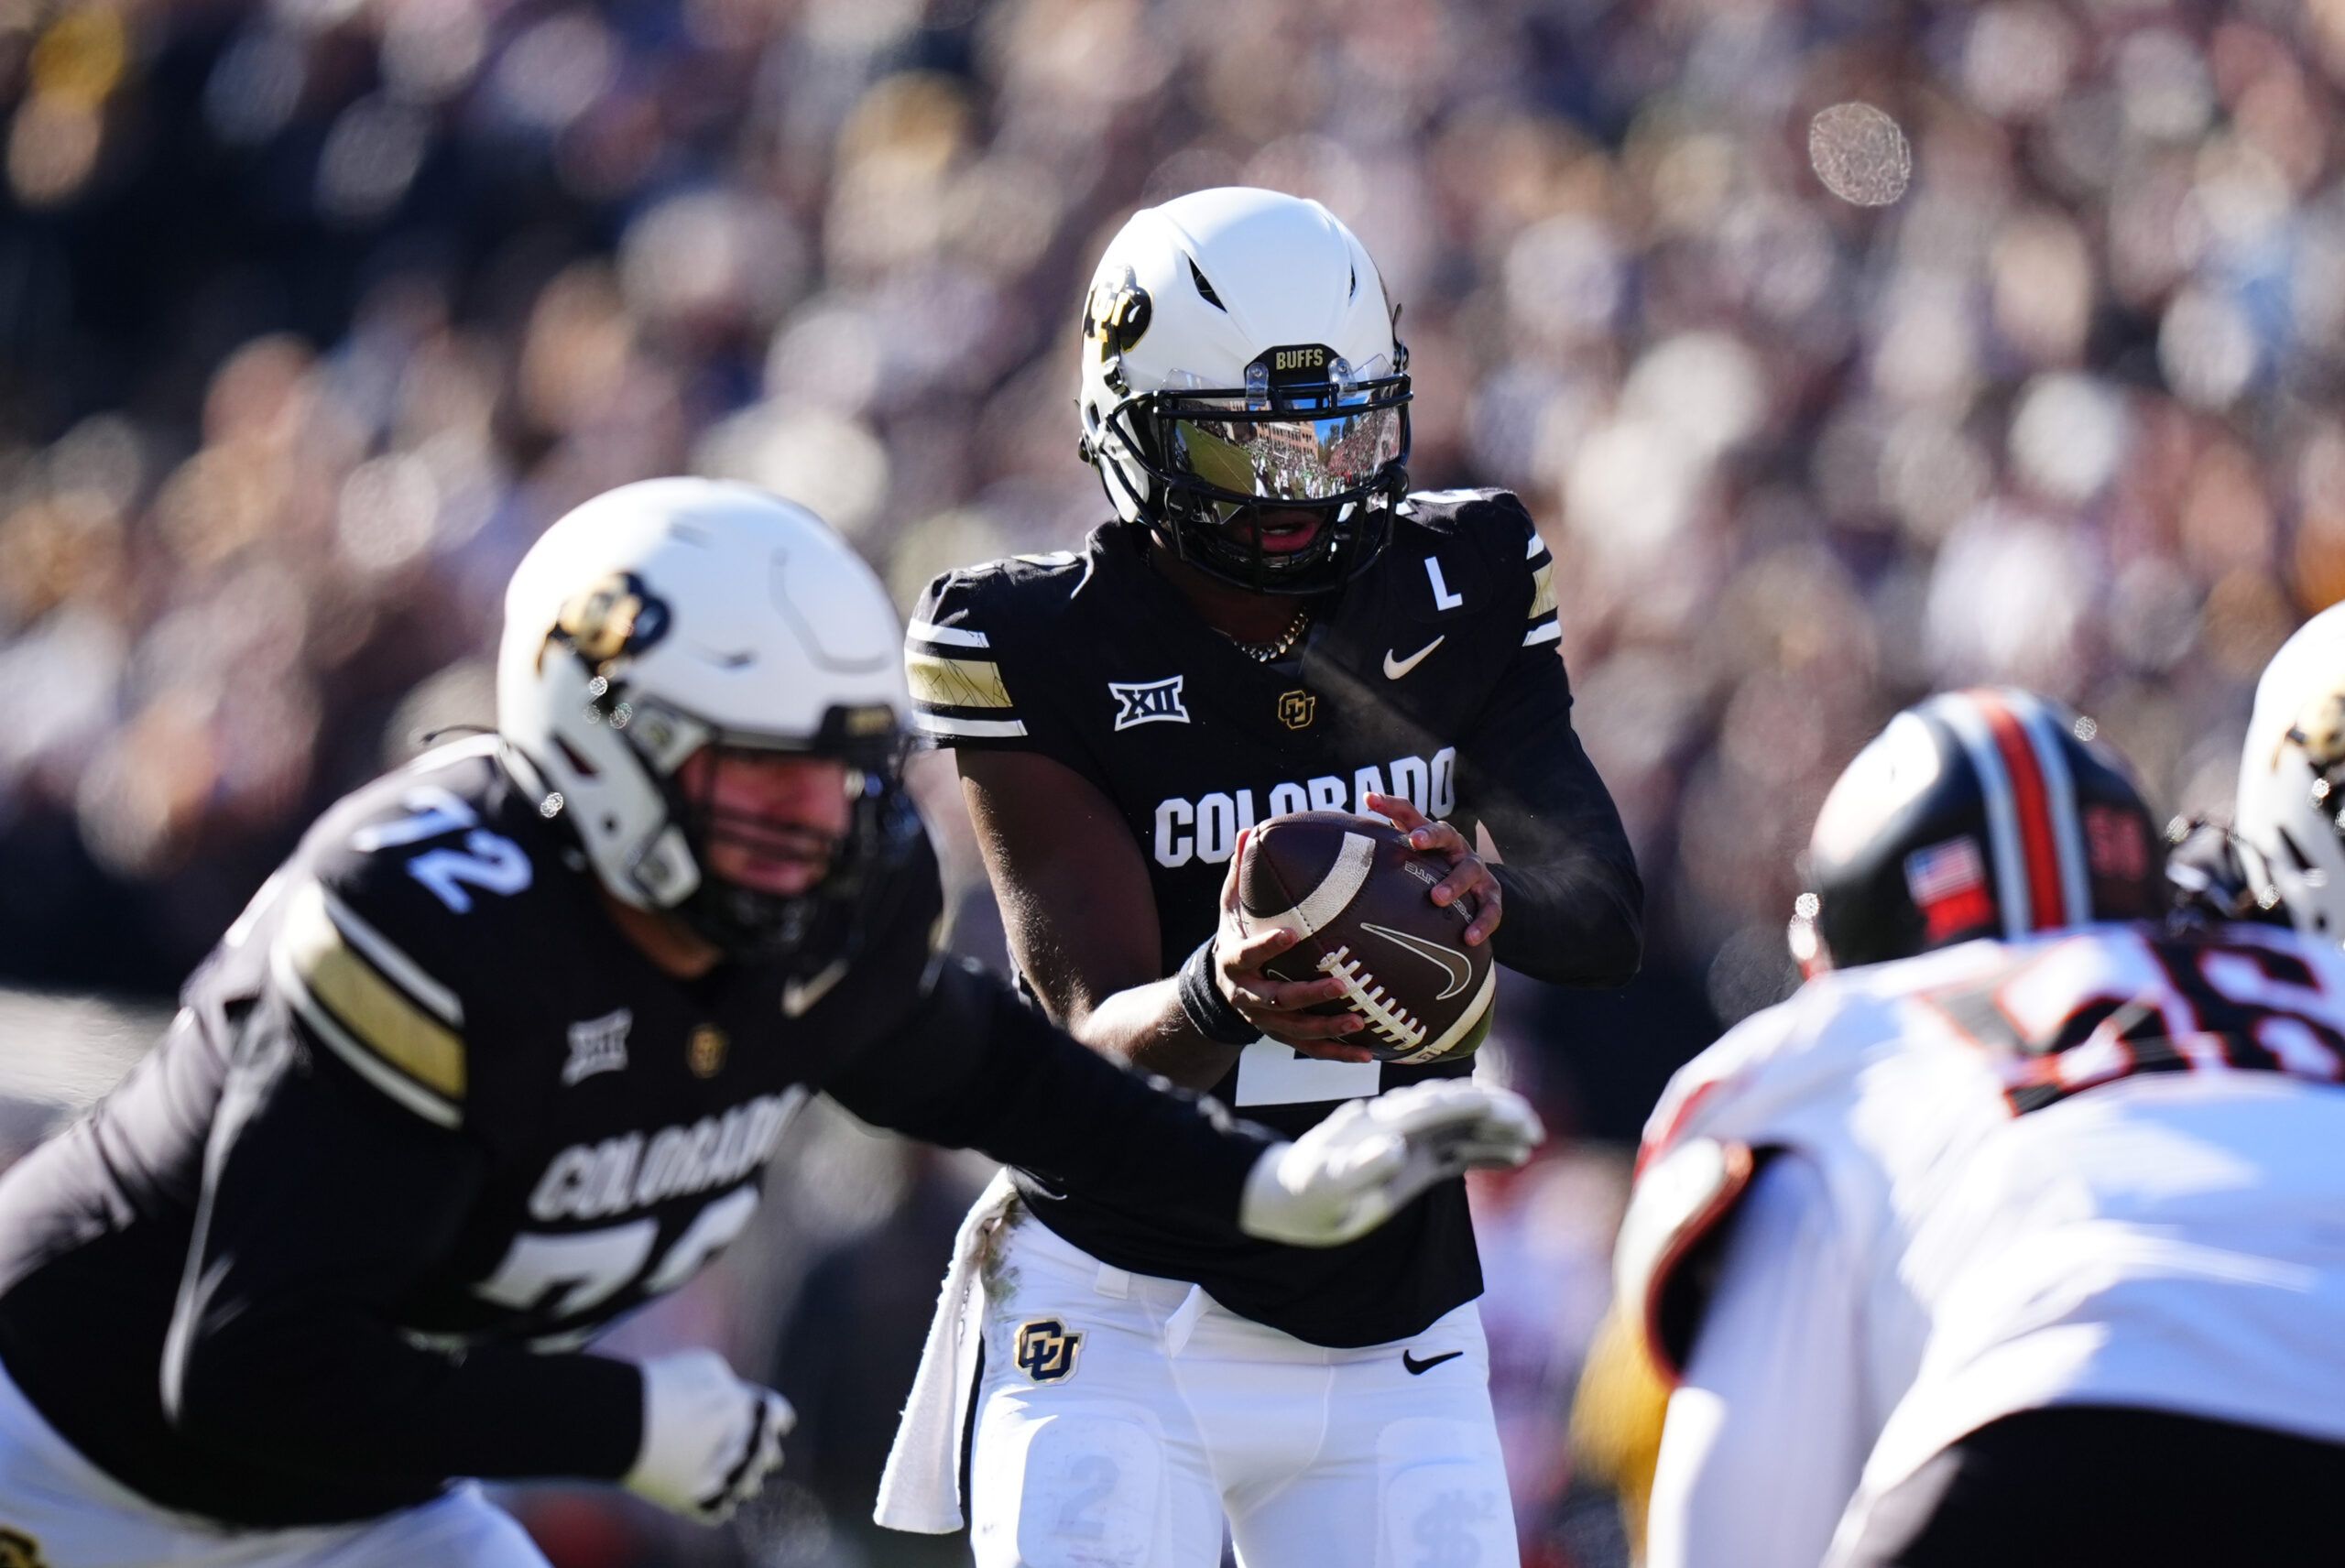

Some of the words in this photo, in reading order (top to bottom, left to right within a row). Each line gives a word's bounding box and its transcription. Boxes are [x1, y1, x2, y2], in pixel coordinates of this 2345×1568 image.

[1275, 348, 1324, 371] BUFFS
[1423, 555, 1463, 611] L
[1108, 676, 1190, 731] XII
[1279, 690, 1315, 730] CU
[348, 784, 533, 914] 72
[1014, 1318, 1085, 1384] CU
